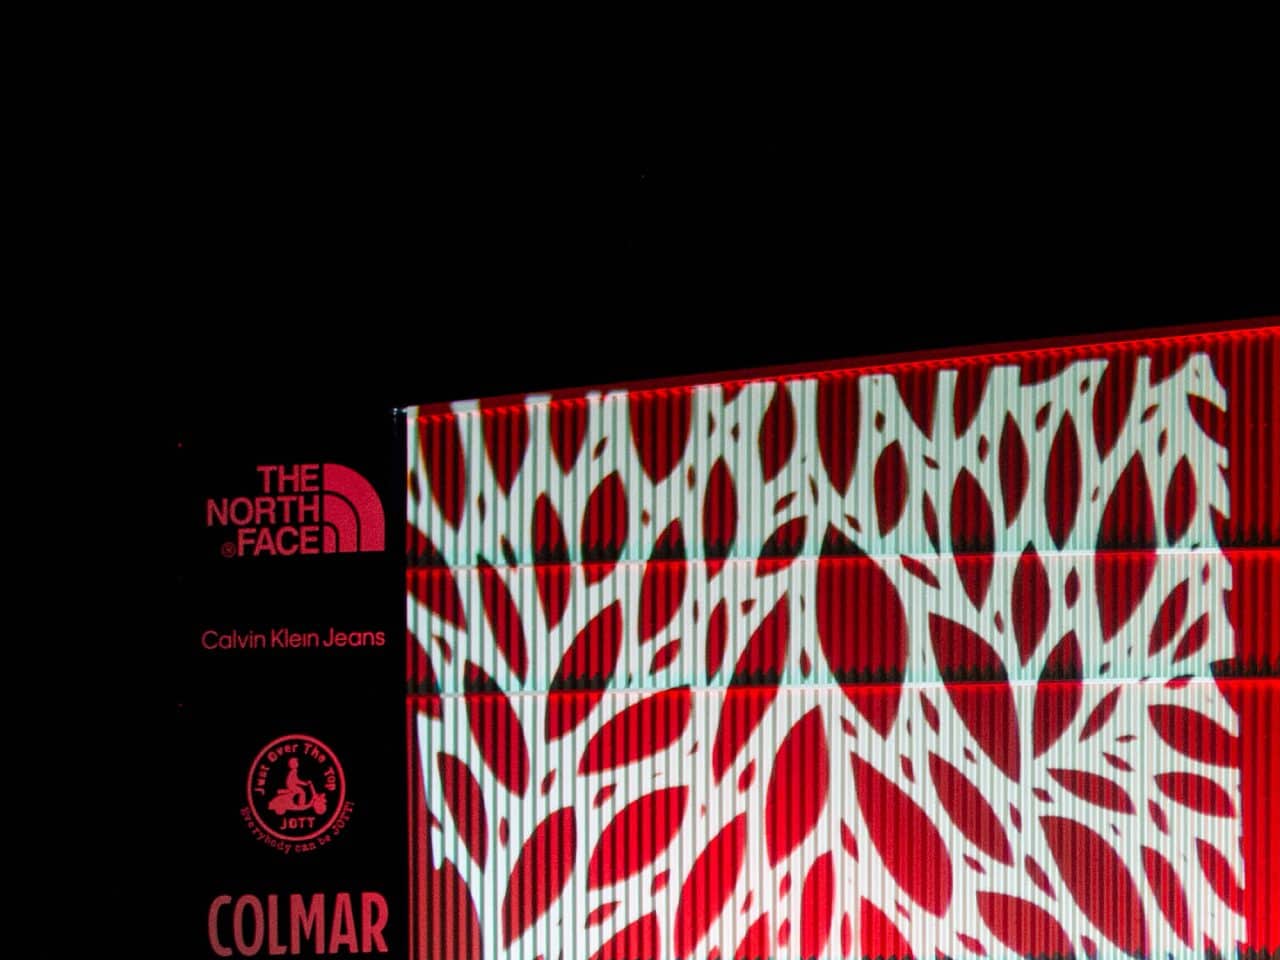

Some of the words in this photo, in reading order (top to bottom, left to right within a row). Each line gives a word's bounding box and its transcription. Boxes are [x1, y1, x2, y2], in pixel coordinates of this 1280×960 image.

[256, 463, 320, 494] THE
[206, 494, 320, 527] NORTH
[237, 525, 320, 557] FACE
[201, 629, 266, 650] Calvin
[270, 627, 320, 649] Klein
[322, 627, 386, 648] Jeans
[267, 744, 299, 763] Over
[304, 742, 326, 763] The
[324, 766, 336, 791] Top
[280, 817, 316, 830] JOTT
[208, 892, 390, 957] COLMAR
